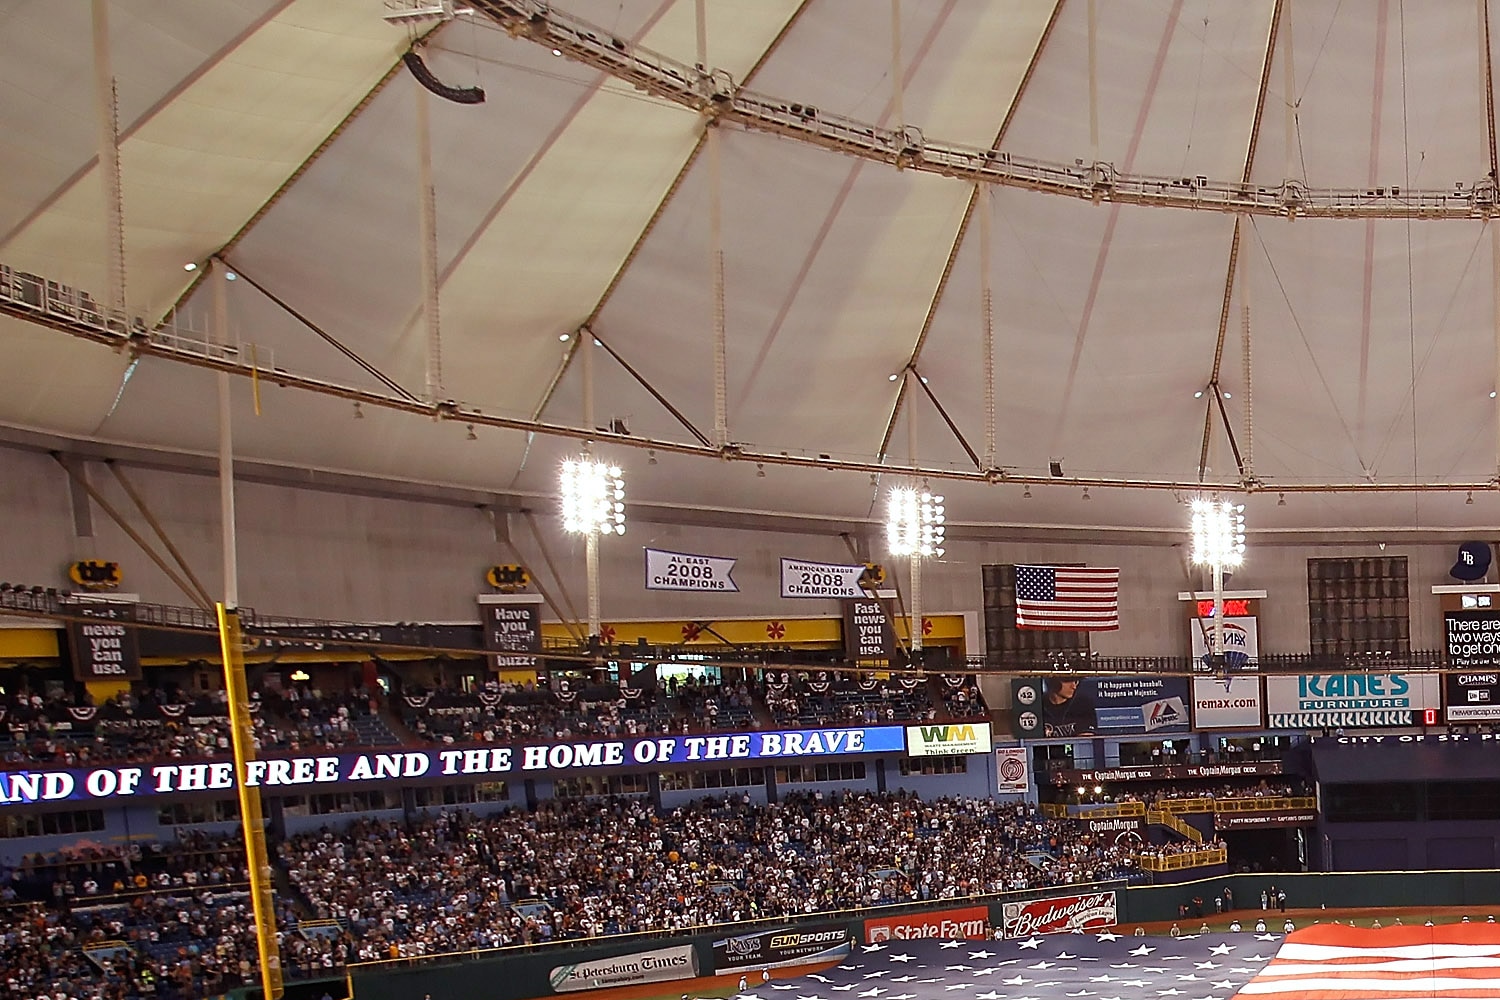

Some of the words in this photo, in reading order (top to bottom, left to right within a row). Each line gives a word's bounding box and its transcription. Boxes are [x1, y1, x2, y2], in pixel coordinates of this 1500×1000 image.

[671, 556, 683, 564] AL
[687, 557, 709, 565] EAST
[1461, 551, 1474, 565] TB
[668, 563, 713, 578] 2008
[788, 565, 825, 573] AMERICAN
[654, 576, 725, 589] CHAMPIONS
[801, 573, 844, 586] 2008
[788, 585, 855, 596] CHAMPIONS
[855, 602, 881, 614] Fast
[495, 608, 531, 620] Have
[854, 614, 886, 624] news
[500, 621, 527, 634] you
[1446, 618, 1480, 631] There
[1482, 620, 1500, 631] are
[83, 625, 126, 636] news
[859, 625, 882, 636] you
[860, 635, 882, 645] can
[1449, 632, 1472, 643] two
[90, 638, 121, 652] you
[859, 646, 884, 655] use.
[1449, 642, 1462, 655] to
[1463, 643, 1482, 657] get
[92, 651, 123, 662] can
[92, 663, 126, 674] use.
[1458, 674, 1498, 685] CHAMPS
[1109, 681, 1132, 690] happens
[1298, 675, 1409, 697] KANE'S
[1104, 690, 1127, 698] happens
[1196, 698, 1256, 709] remax.com
[1303, 699, 1404, 709] FURNITURE
[1150, 713, 1179, 726] Majestic
[920, 725, 976, 743] WM
[1337, 736, 1385, 744] CITY
[1438, 734, 1469, 742] ST.
[86, 767, 142, 798] OF
[152, 762, 234, 793] THE
[243, 755, 340, 787] FREE
[348, 752, 431, 781] AND
[439, 747, 512, 776] THE
[520, 741, 625, 771] HOME
[632, 738, 676, 764] OF
[683, 734, 751, 761] THE
[759, 729, 866, 757] BRAVE
[1082, 773, 1093, 781] THE
[1089, 820, 1113, 832] Captain
[1112, 819, 1139, 831] Morgan
[1008, 893, 1104, 937] Budweiser
[893, 921, 941, 939] State
[941, 917, 984, 938] Farm
[728, 954, 745, 962] YOUR
[583, 964, 640, 980] Petersburg
[640, 954, 688, 972] Times
